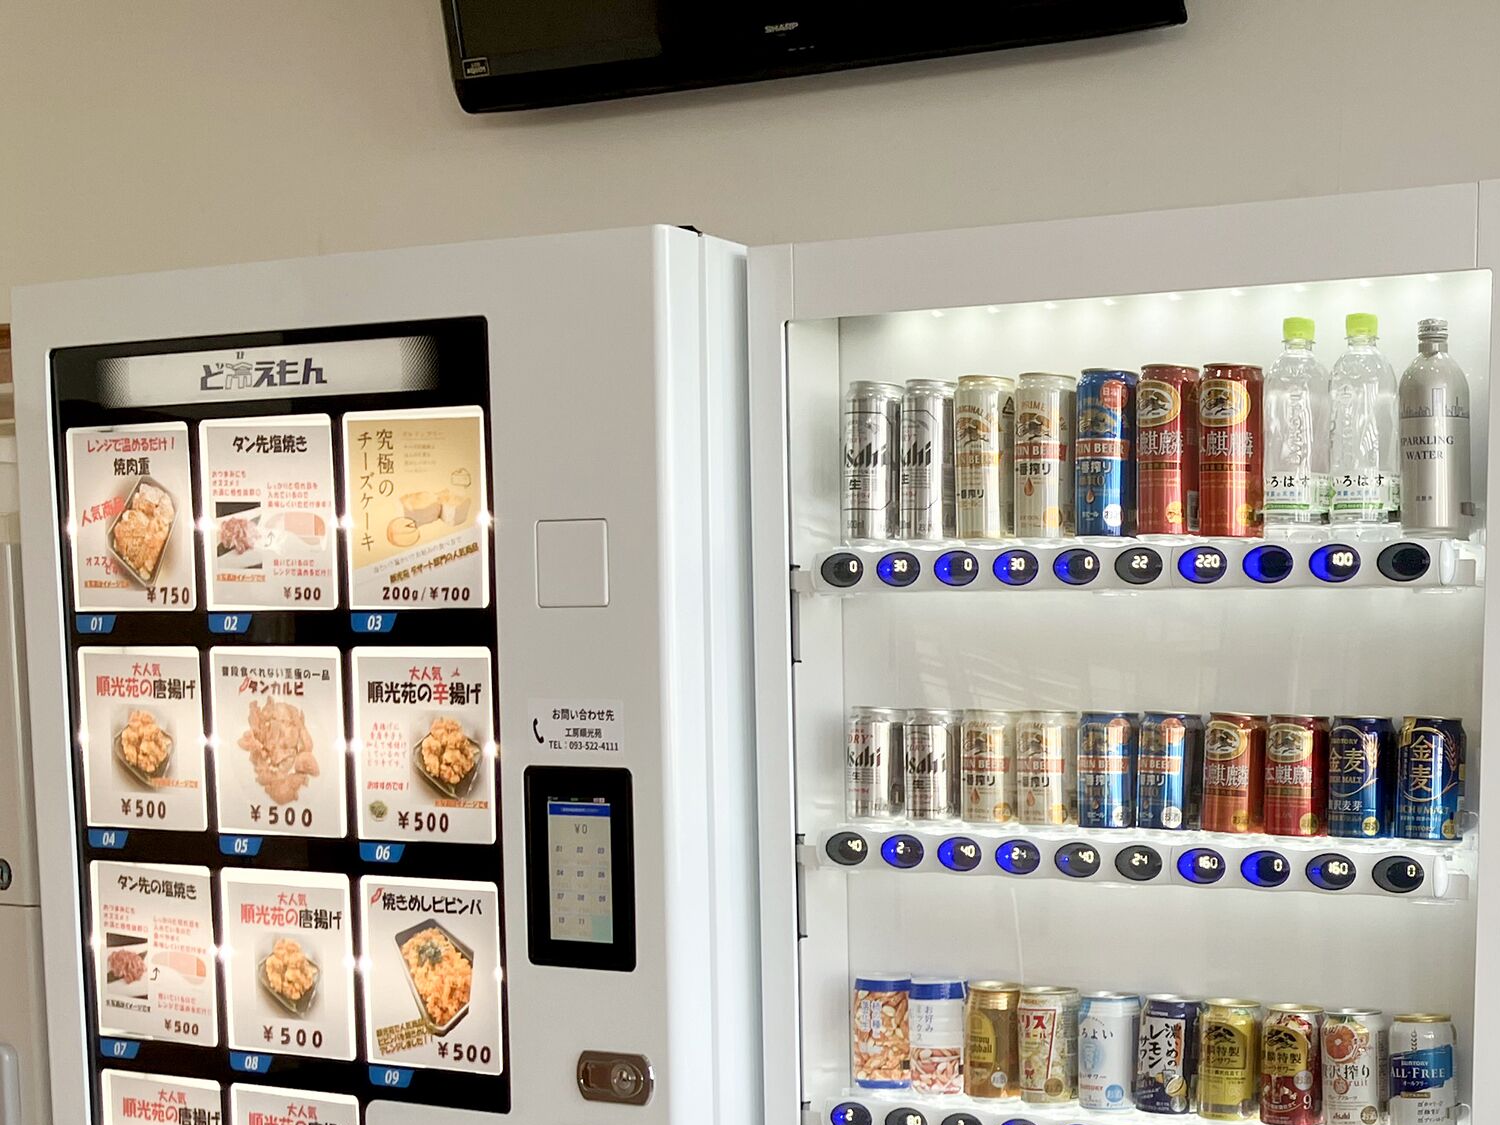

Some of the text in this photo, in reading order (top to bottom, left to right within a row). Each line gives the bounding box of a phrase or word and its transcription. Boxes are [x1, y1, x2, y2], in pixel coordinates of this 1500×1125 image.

[764, 22, 798, 34] SHARP
[233, 435, 307, 453] タン先塩焼き
[1406, 450, 1444, 460] WATER
[114, 457, 150, 475] 焼肉重
[376, 428, 394, 497] 究極の
[358, 432, 375, 551] チーズケーキ
[849, 479, 861, 490] 生
[1195, 554, 1220, 568] 220
[147, 587, 189, 604] ¥750
[284, 587, 321, 601] ¥500
[90, 617, 103, 631] 01
[224, 616, 237, 631] 02
[368, 616, 382, 630] 03
[132, 663, 161, 676] 大人気
[409, 666, 443, 680] 大人気
[96, 676, 196, 700] 順光苑の唐揚げ
[249, 680, 304, 696] タンカルビ
[368, 681, 481, 704] 順光苑の辛揚げ
[552, 708, 614, 721] お問い合わせ先
[565, 728, 602, 738] 工房順光苑
[1410, 734, 1432, 792] 金麦
[121, 799, 166, 819] ¥500
[398, 811, 449, 832] ¥500
[102, 832, 115, 845] 04
[235, 839, 248, 852] 05
[375, 845, 390, 860] 06
[117, 875, 197, 900] タン先の塩焼き
[278, 892, 307, 906] 大人気
[241, 904, 342, 930] 順光苑の唐揚げ
[164, 1019, 199, 1035] ¥500
[114, 1042, 126, 1055] 07
[438, 1042, 491, 1063] ¥500
[245, 1057, 258, 1070] 08
[385, 1070, 399, 1084] 09
[1391, 1068, 1446, 1079] ALL-FREE
